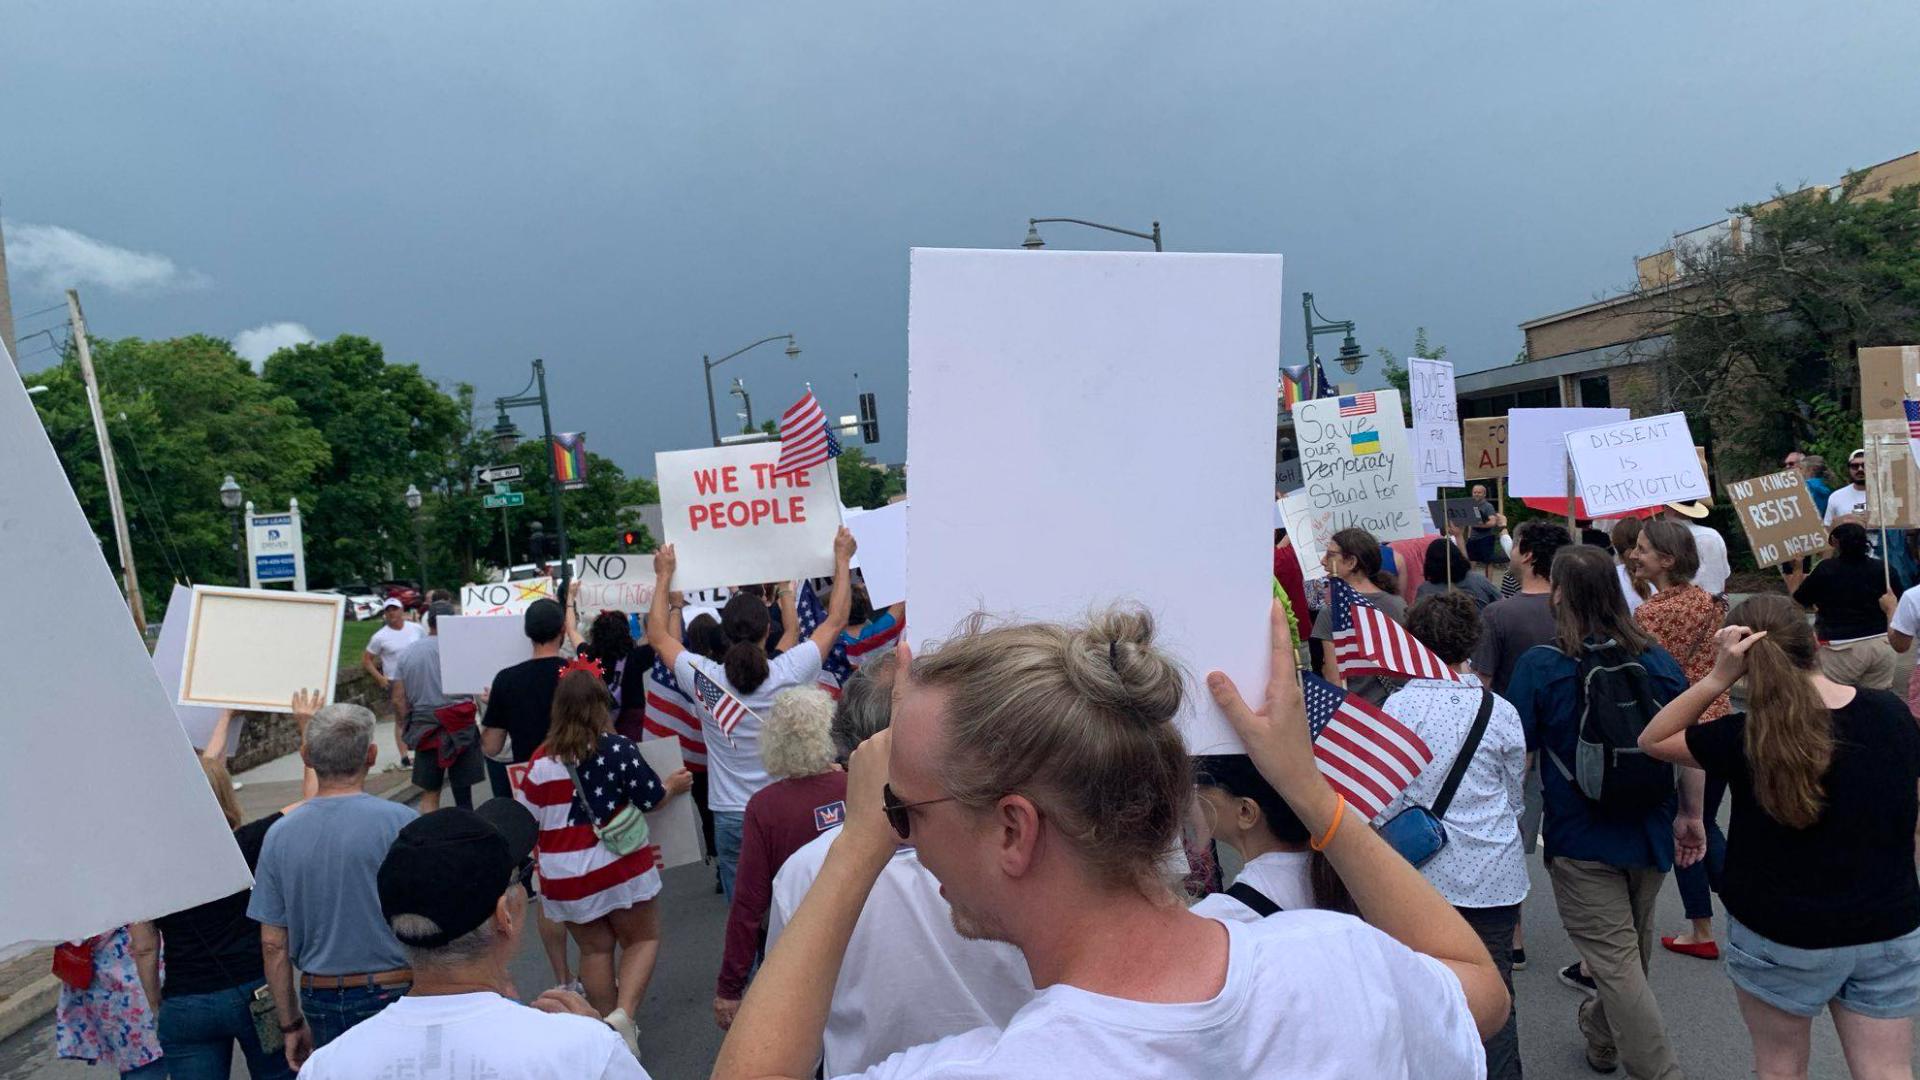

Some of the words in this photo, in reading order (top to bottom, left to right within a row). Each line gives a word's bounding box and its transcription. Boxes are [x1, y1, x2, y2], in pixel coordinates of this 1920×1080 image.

[1300, 404, 1376, 444] Save
[1489, 425, 1508, 444] FO
[1590, 422, 1670, 448] DISSENT
[1303, 452, 1395, 481] Democracy
[1424, 449, 1457, 474] ALL
[1479, 449, 1508, 469] AL
[1619, 456, 1638, 469] IS
[693, 466, 739, 496] WE
[750, 463, 811, 490] THE
[1587, 470, 1697, 504] PATRIOTIC
[1734, 480, 1754, 500] NO
[1759, 471, 1799, 493] KINGS
[1309, 479, 1368, 509] Stand
[688, 496, 807, 531] PEOPLE
[1332, 510, 1411, 533] Ukraine
[1748, 495, 1802, 529] RESIST
[1759, 543, 1779, 565] NO
[1783, 532, 1825, 556] NAZIS
[577, 555, 627, 581] NO
[466, 585, 510, 606] NO
[577, 582, 656, 609] DICTATOR
